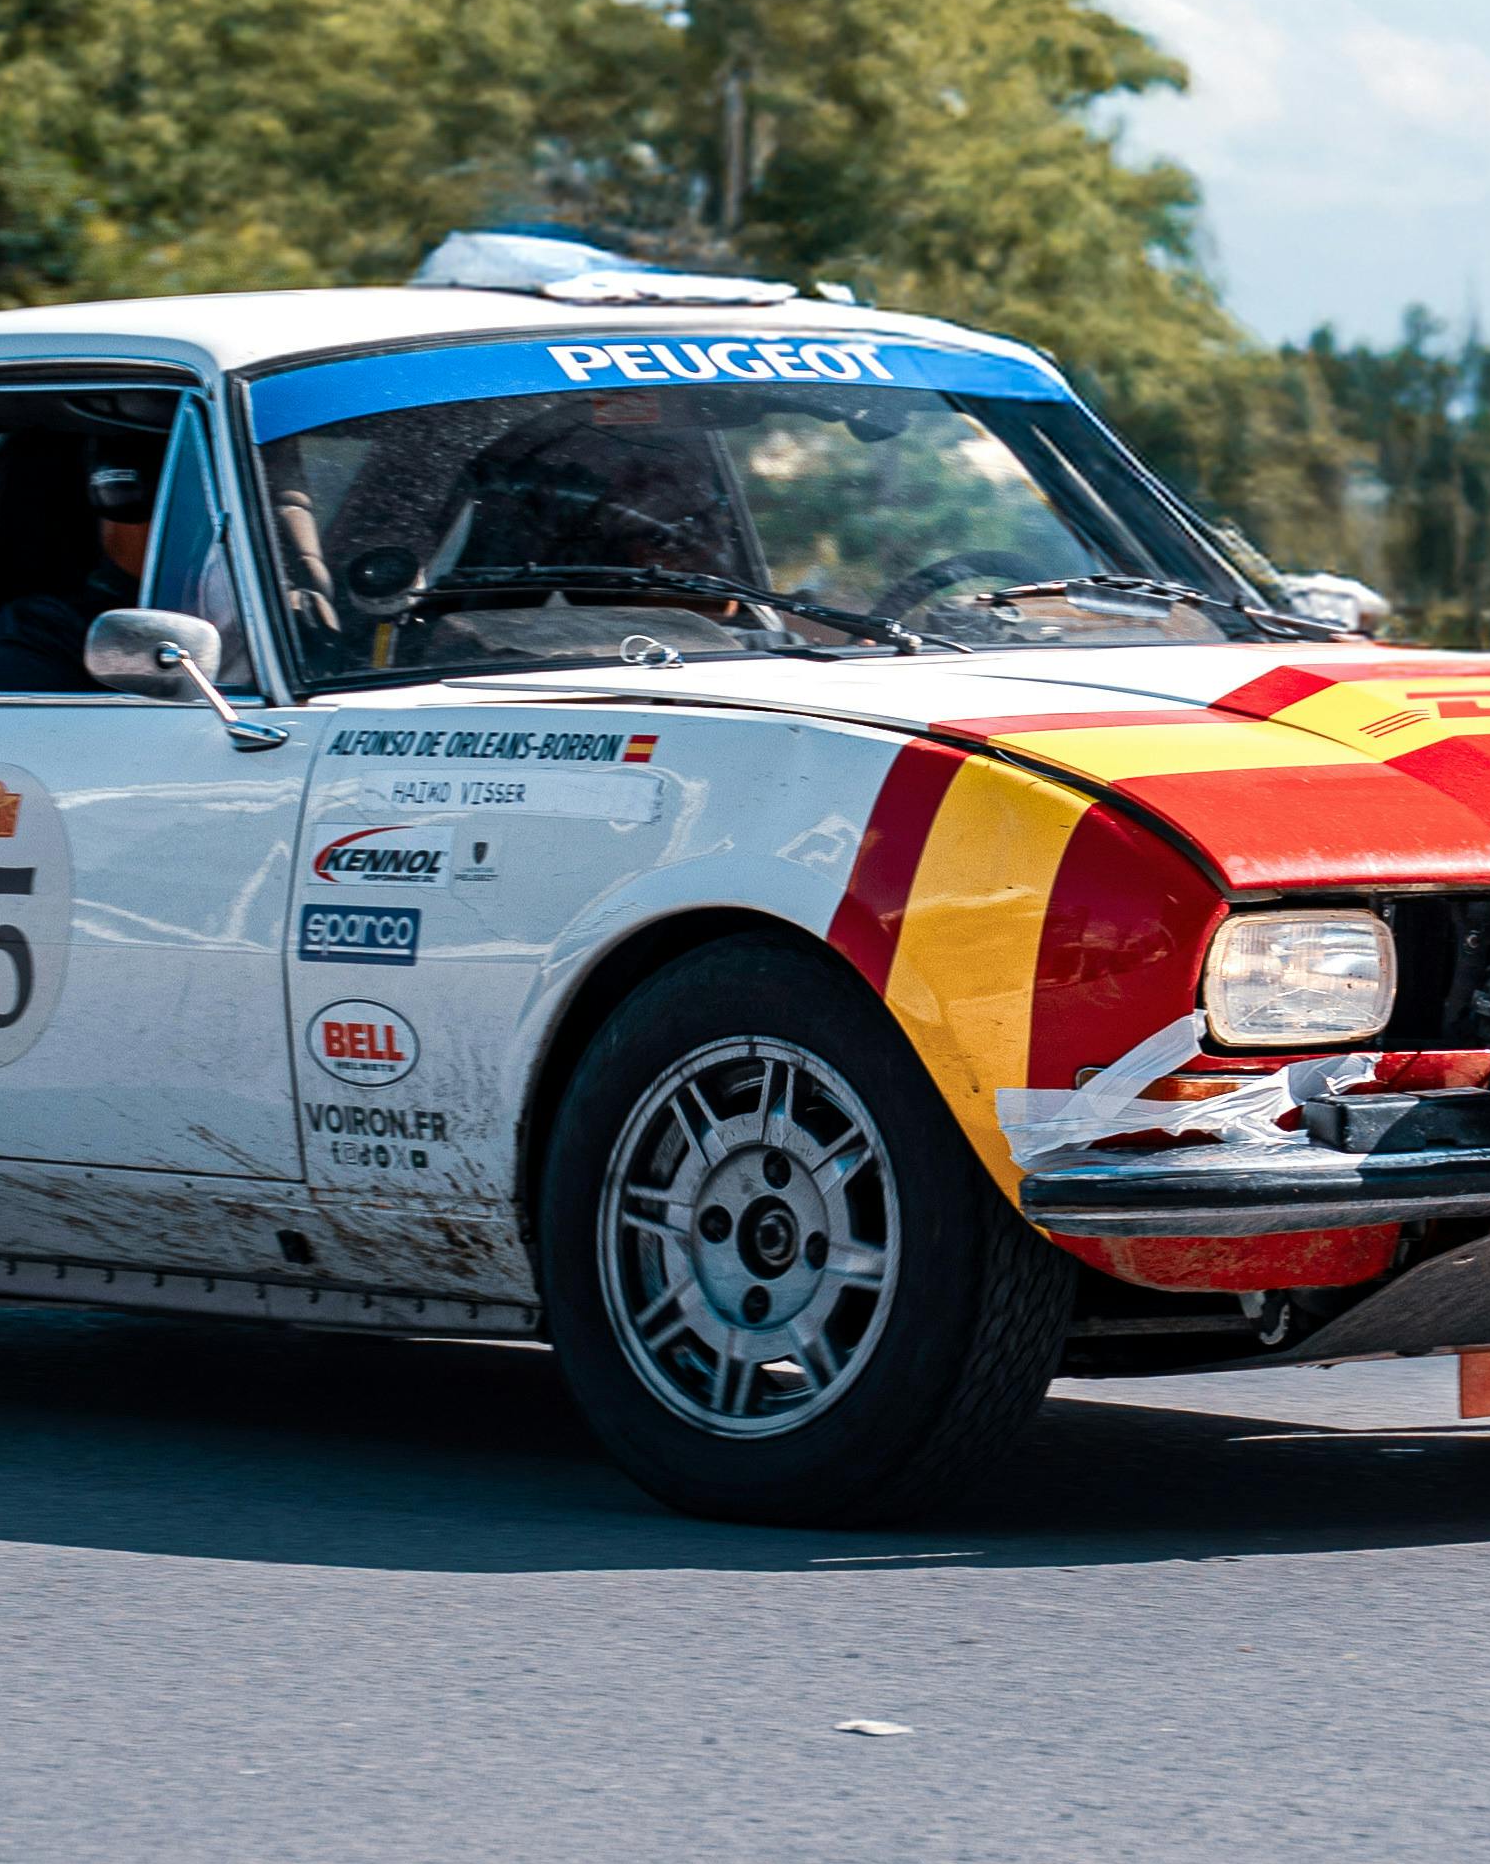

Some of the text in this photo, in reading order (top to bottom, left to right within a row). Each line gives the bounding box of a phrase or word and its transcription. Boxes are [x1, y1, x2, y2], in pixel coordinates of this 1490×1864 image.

[546, 341, 895, 381] PEUGEOT
[326, 730, 623, 762] ALFONSO DE ORLEANS-BORBON
[460, 781, 526, 806] VISSER
[321, 847, 447, 874] KENNOL
[306, 912, 415, 956] sparco
[323, 1021, 406, 1061] BELL
[304, 1103, 449, 1142] VOIRON.FR
